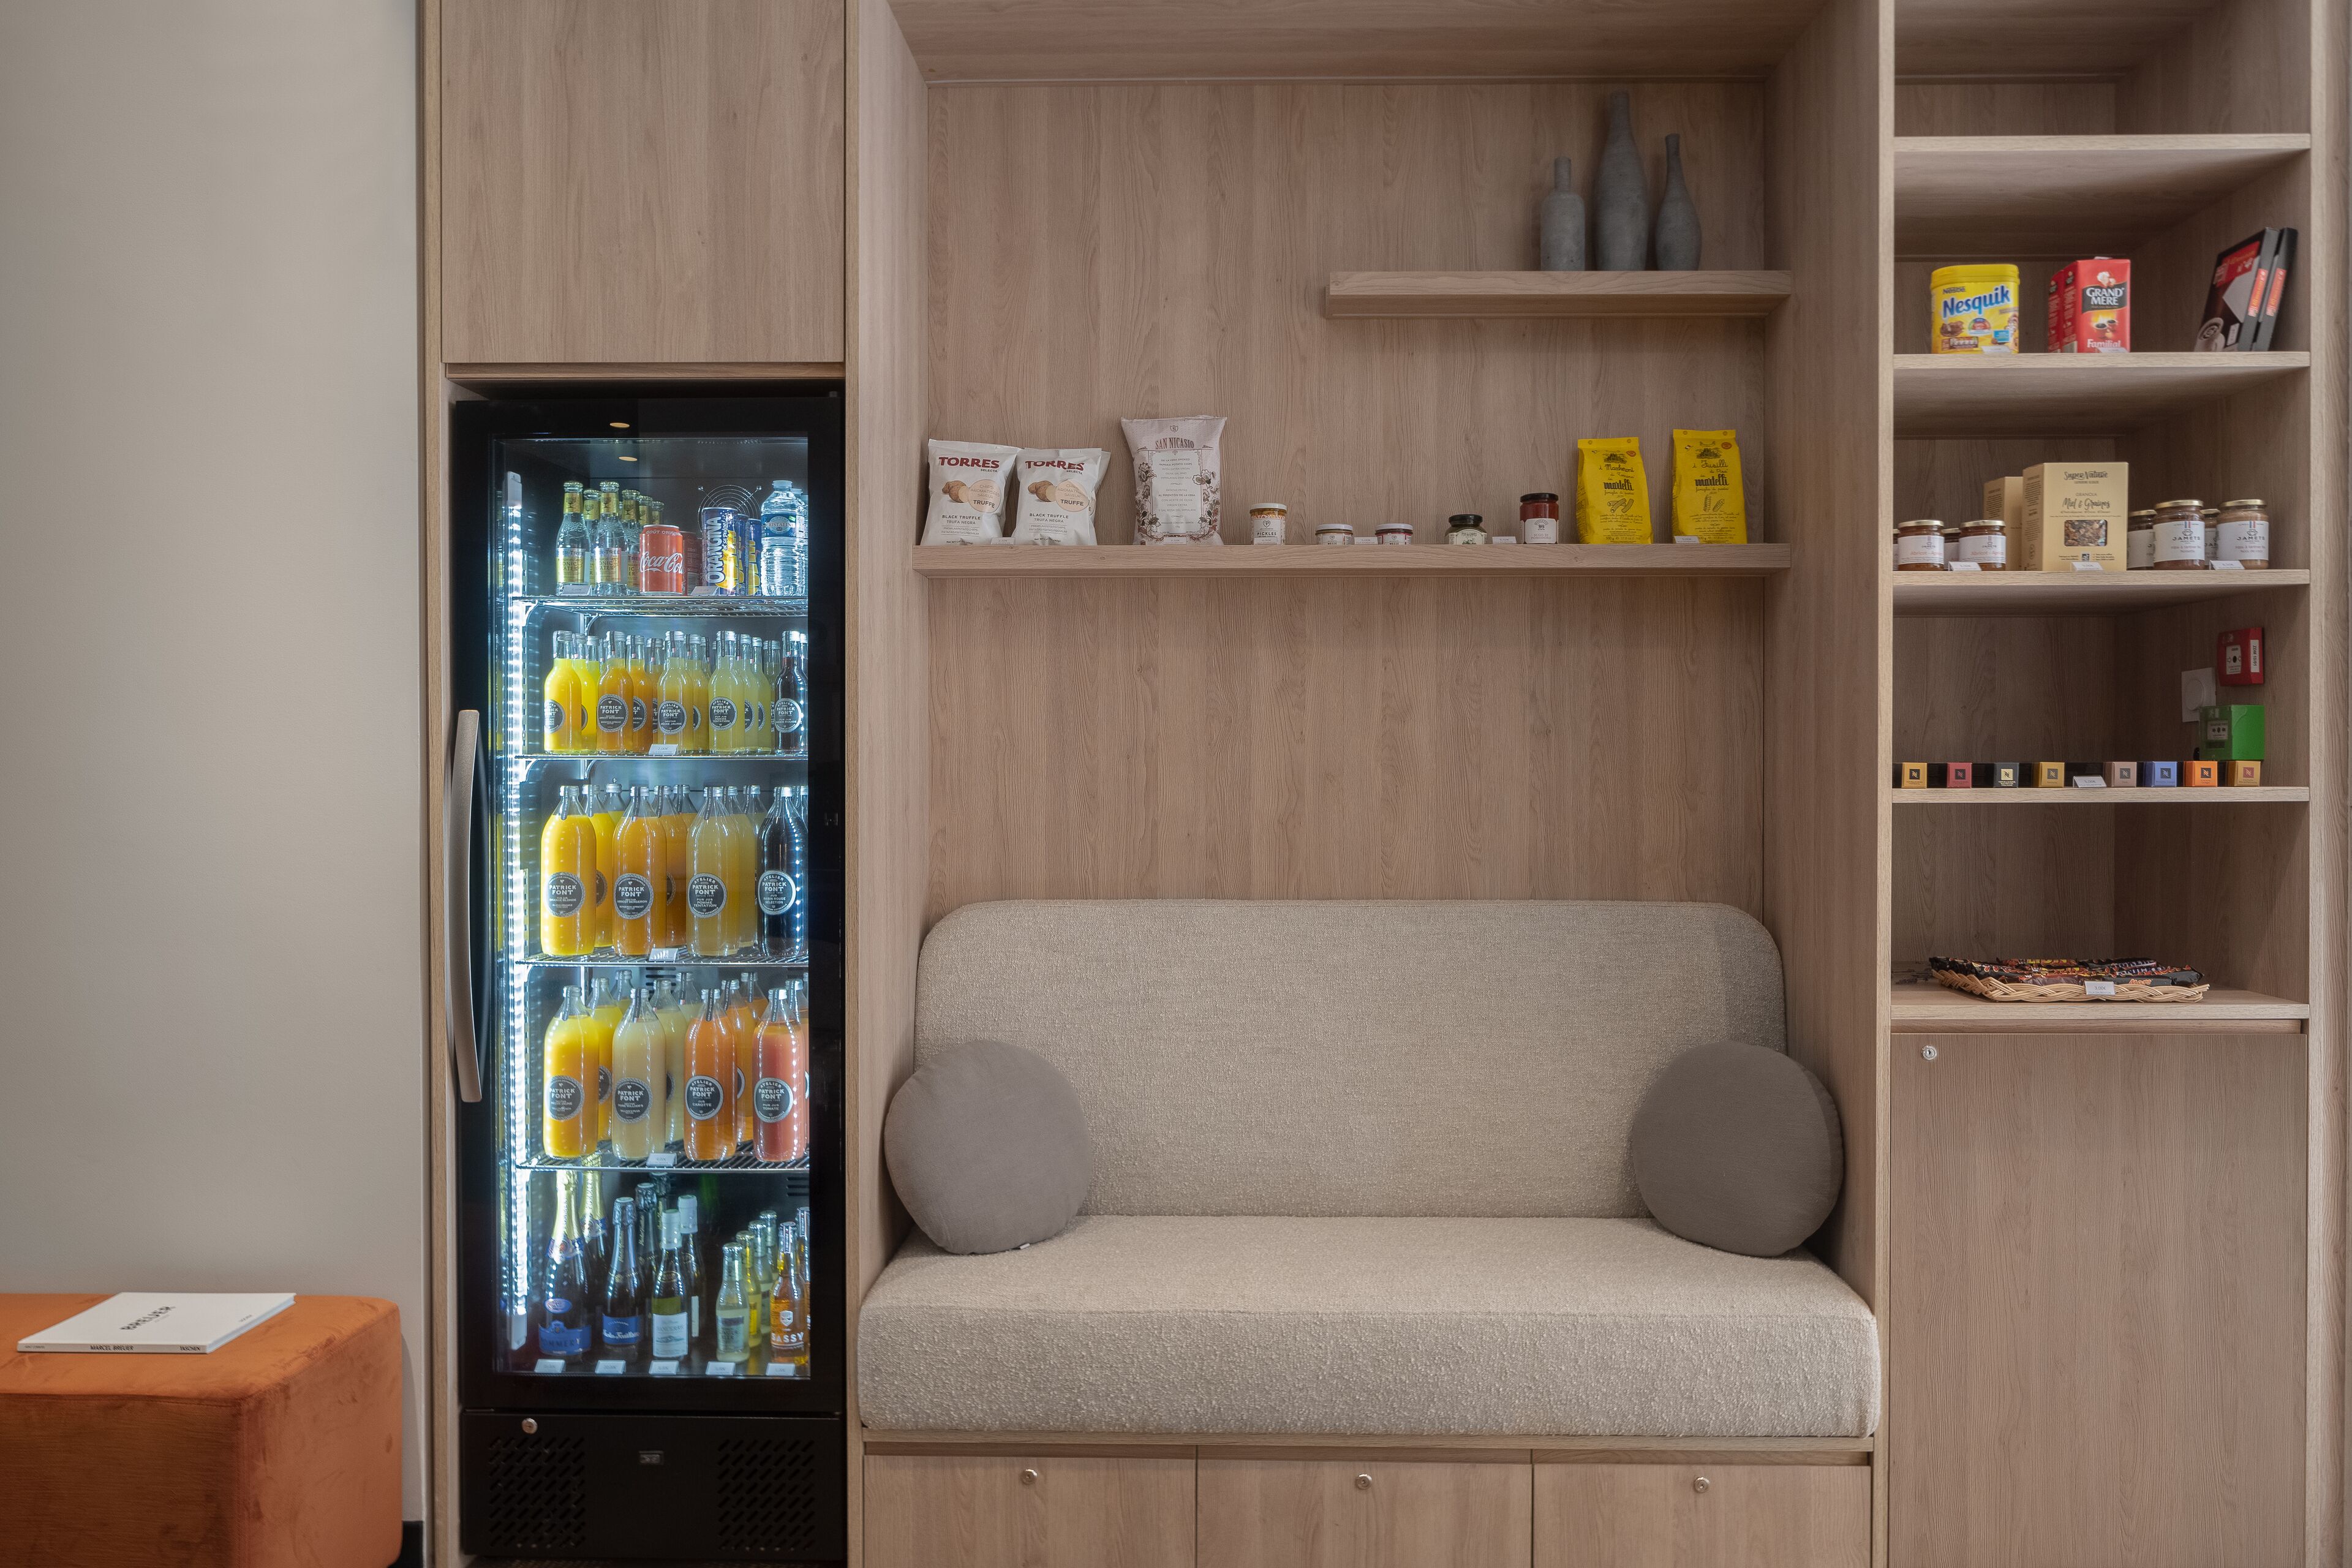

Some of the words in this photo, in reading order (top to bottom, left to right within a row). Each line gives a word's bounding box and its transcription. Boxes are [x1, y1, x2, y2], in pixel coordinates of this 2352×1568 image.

[1942, 285, 2010, 318] Nesquik
[2087, 339, 2121, 348] Familial
[1155, 437, 1168, 450] SAN
[1169, 437, 1194, 449] NICASIO
[938, 457, 1000, 469] TORRES
[1025, 460, 1085, 471] TORRES
[1605, 464, 1635, 473] Maccheroni
[1701, 459, 1728, 469] Fusilli
[1603, 478, 1635, 491] martelli
[1694, 473, 1729, 486] martelli
[973, 500, 995, 508] TRUFFE
[2062, 498, 2078, 509] Miel
[2084, 498, 2111, 510] Graines
[705, 516, 725, 583] ORANGINA
[771, 1332, 804, 1343] SASSY
